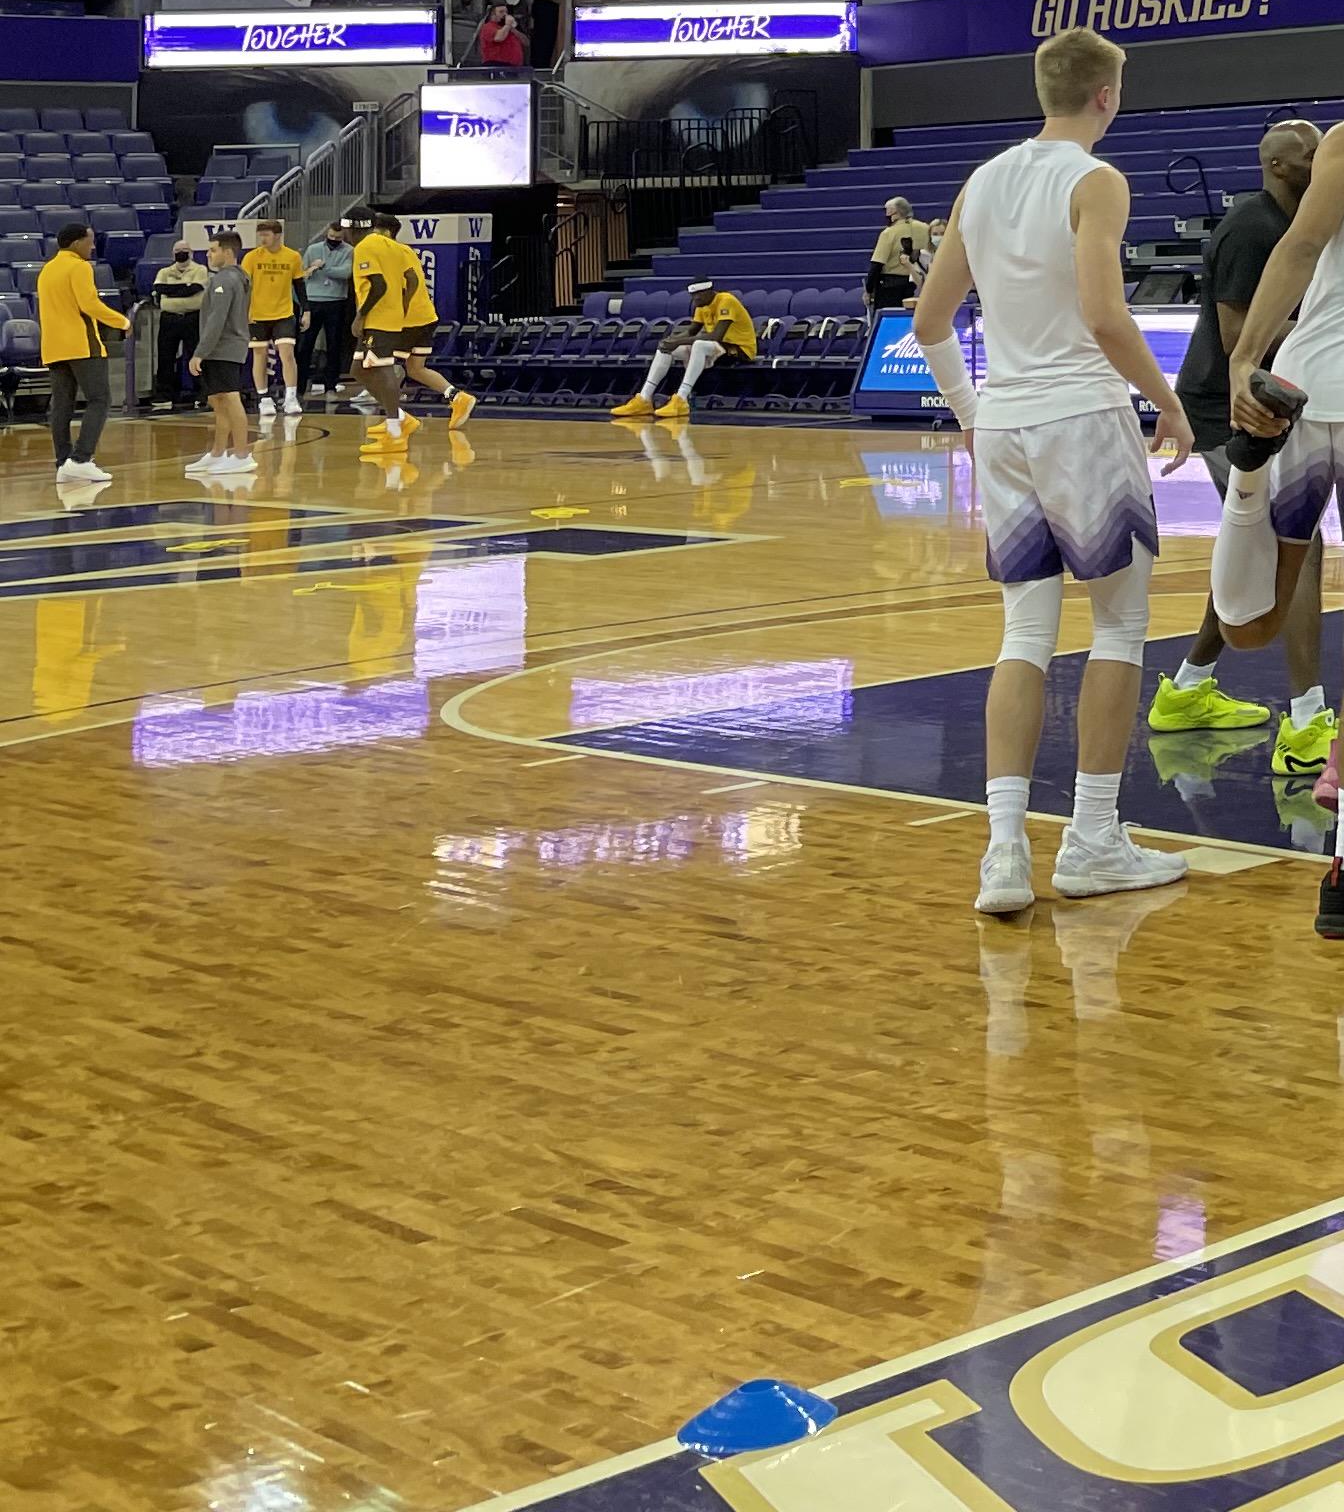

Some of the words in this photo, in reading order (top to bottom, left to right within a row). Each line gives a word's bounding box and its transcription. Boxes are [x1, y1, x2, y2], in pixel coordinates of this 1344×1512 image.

[241, 22, 347, 52] TOUGHER
[670, 13, 771, 43] TOUGHER
[410, 218, 440, 239] W
[468, 217, 483, 238] W
